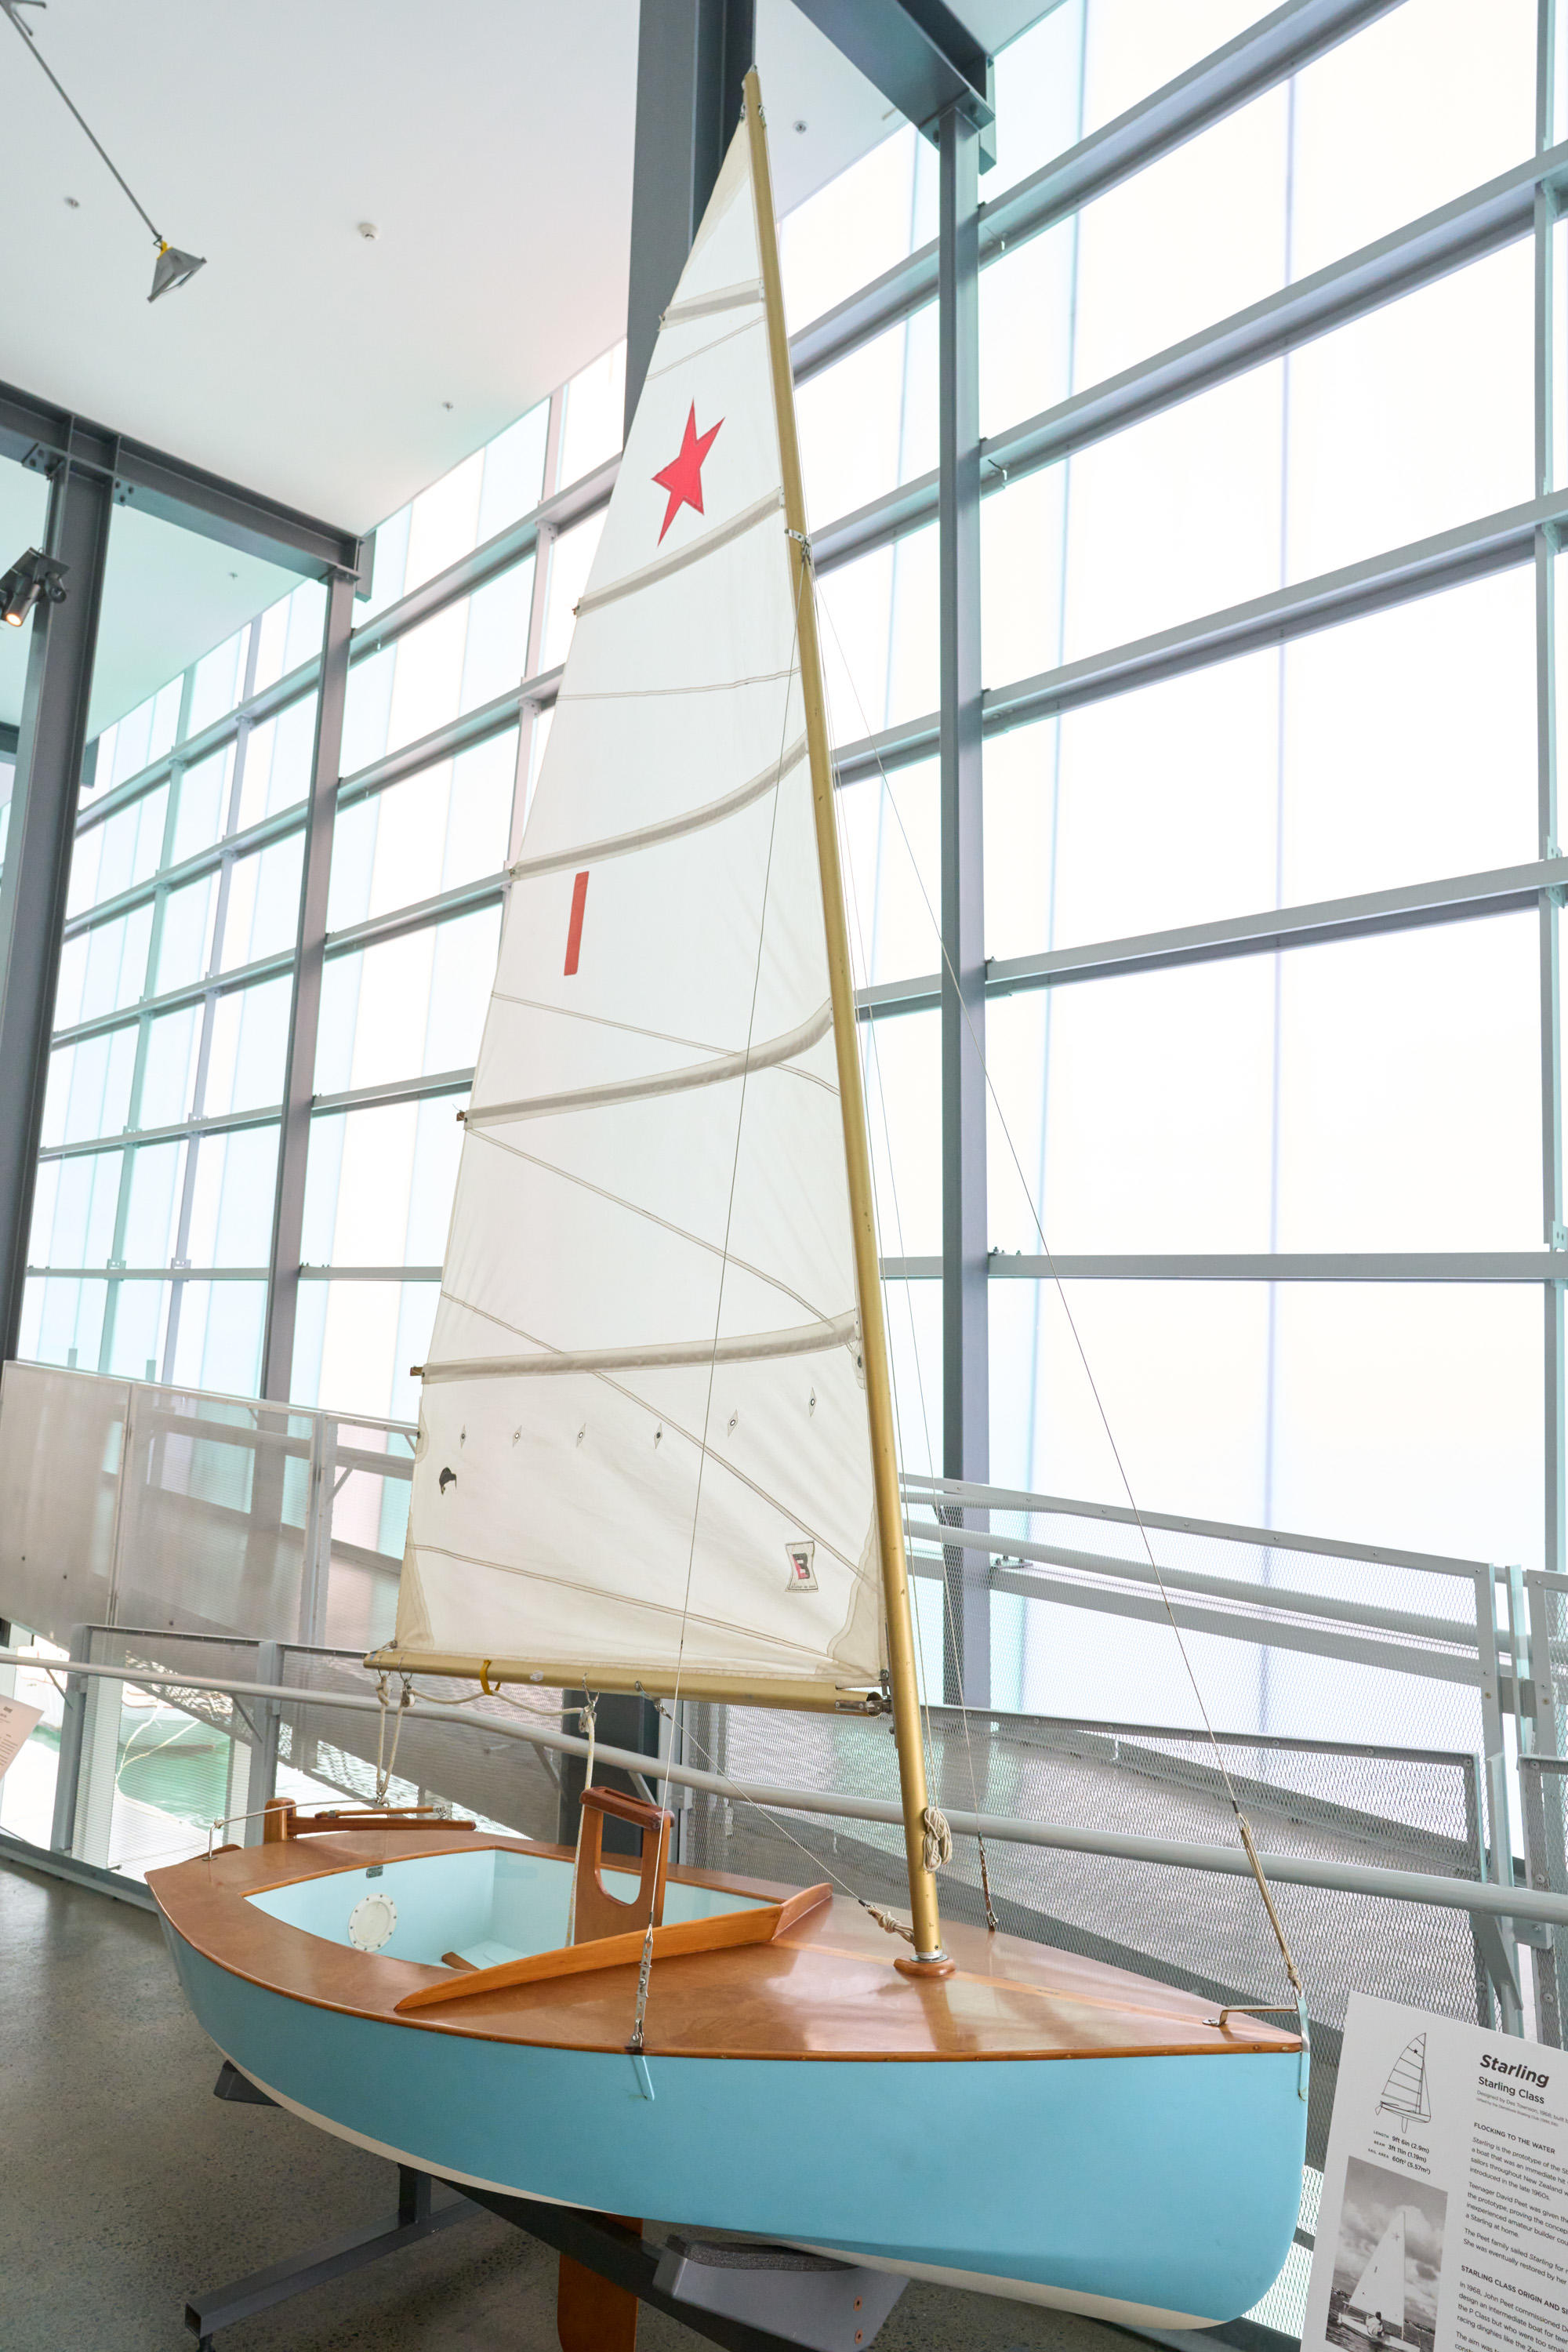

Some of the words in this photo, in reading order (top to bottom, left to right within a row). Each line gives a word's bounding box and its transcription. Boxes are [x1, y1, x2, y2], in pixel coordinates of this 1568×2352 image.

[1480, 2054, 1549, 2088] Starling
[1477, 2090, 1498, 2100] Designed
[1479, 2076, 1515, 2096] Starling
[1519, 2089, 1544, 2103] Class
[1411, 2143, 1429, 2154] (2.9m)
[1472, 2137, 1494, 2149] Starling
[1512, 2151, 1541, 2165] prototype
[1474, 2122, 1505, 2137] FLOCKING
[1518, 2136, 1530, 2145] THE
[1532, 2142, 1555, 2154] WATER
[1408, 2152, 1426, 2163] (1.19m)
[1470, 2166, 1501, 2182] introduced
[1477, 2148, 1489, 2157] boat
[1526, 2166, 1556, 2181] immediate
[1471, 2158, 1488, 2168] sailors
[1490, 2164, 1522, 2180] throughout
[1524, 2175, 1537, 2184] New
[1539, 2180, 1563, 2194] Zealand
[1469, 2182, 1494, 2195] Teenager
[1496, 2192, 1512, 2202] David
[1515, 2198, 1527, 2209] Peet
[1542, 2210, 1559, 2220] given
[1510, 2209, 1532, 2221] proving
[1534, 2216, 1543, 2225] the
[1467, 2202, 1506, 2222] inexperienced
[1508, 2219, 1532, 2231] amateur
[1534, 2228, 1555, 2241] builder
[1471, 2214, 1492, 2228] Starling
[1464, 2238, 1474, 2247] She
[1489, 2250, 1518, 2265] eventually
[1520, 2263, 1545, 2276] restored
[1556, 2276, 1566, 2285] her
[1465, 2227, 1475, 2236] The
[1477, 2233, 1490, 2242] Peet
[1491, 2239, 1509, 2250] family
[1511, 2247, 1528, 2258] sailed
[1530, 2254, 1553, 2268] Starling
[1461, 2265, 1493, 2283] STARLING
[1495, 2280, 1515, 2292] CLASS
[1518, 2289, 1542, 2303] ORIGIN
[1544, 2300, 1559, 2310] AND
[1459, 2293, 1478, 2305] design
[1489, 2307, 1526, 2326] intermediate
[1528, 2322, 1542, 2333] boat
[1544, 2329, 1553, 2338] for
[1484, 2292, 1498, 2302] John
[1501, 2299, 1514, 2310] Peet
[1515, 2307, 1560, 2328] commissioned
[1457, 2315, 1475, 2328] racing
[1477, 2324, 1502, 2339] dinghies
[1504, 2336, 1514, 2344] like
[1515, 2340, 1526, 2350] the
[1457, 2331, 1467, 2340] The
[1468, 2337, 1479, 2346] aim
[1475, 2311, 1490, 2321] Class
[1492, 2318, 1502, 2327] but
[1504, 2325, 1517, 2334] who
[1519, 2332, 1534, 2342] were
[1536, 2337, 1546, 2347] too
